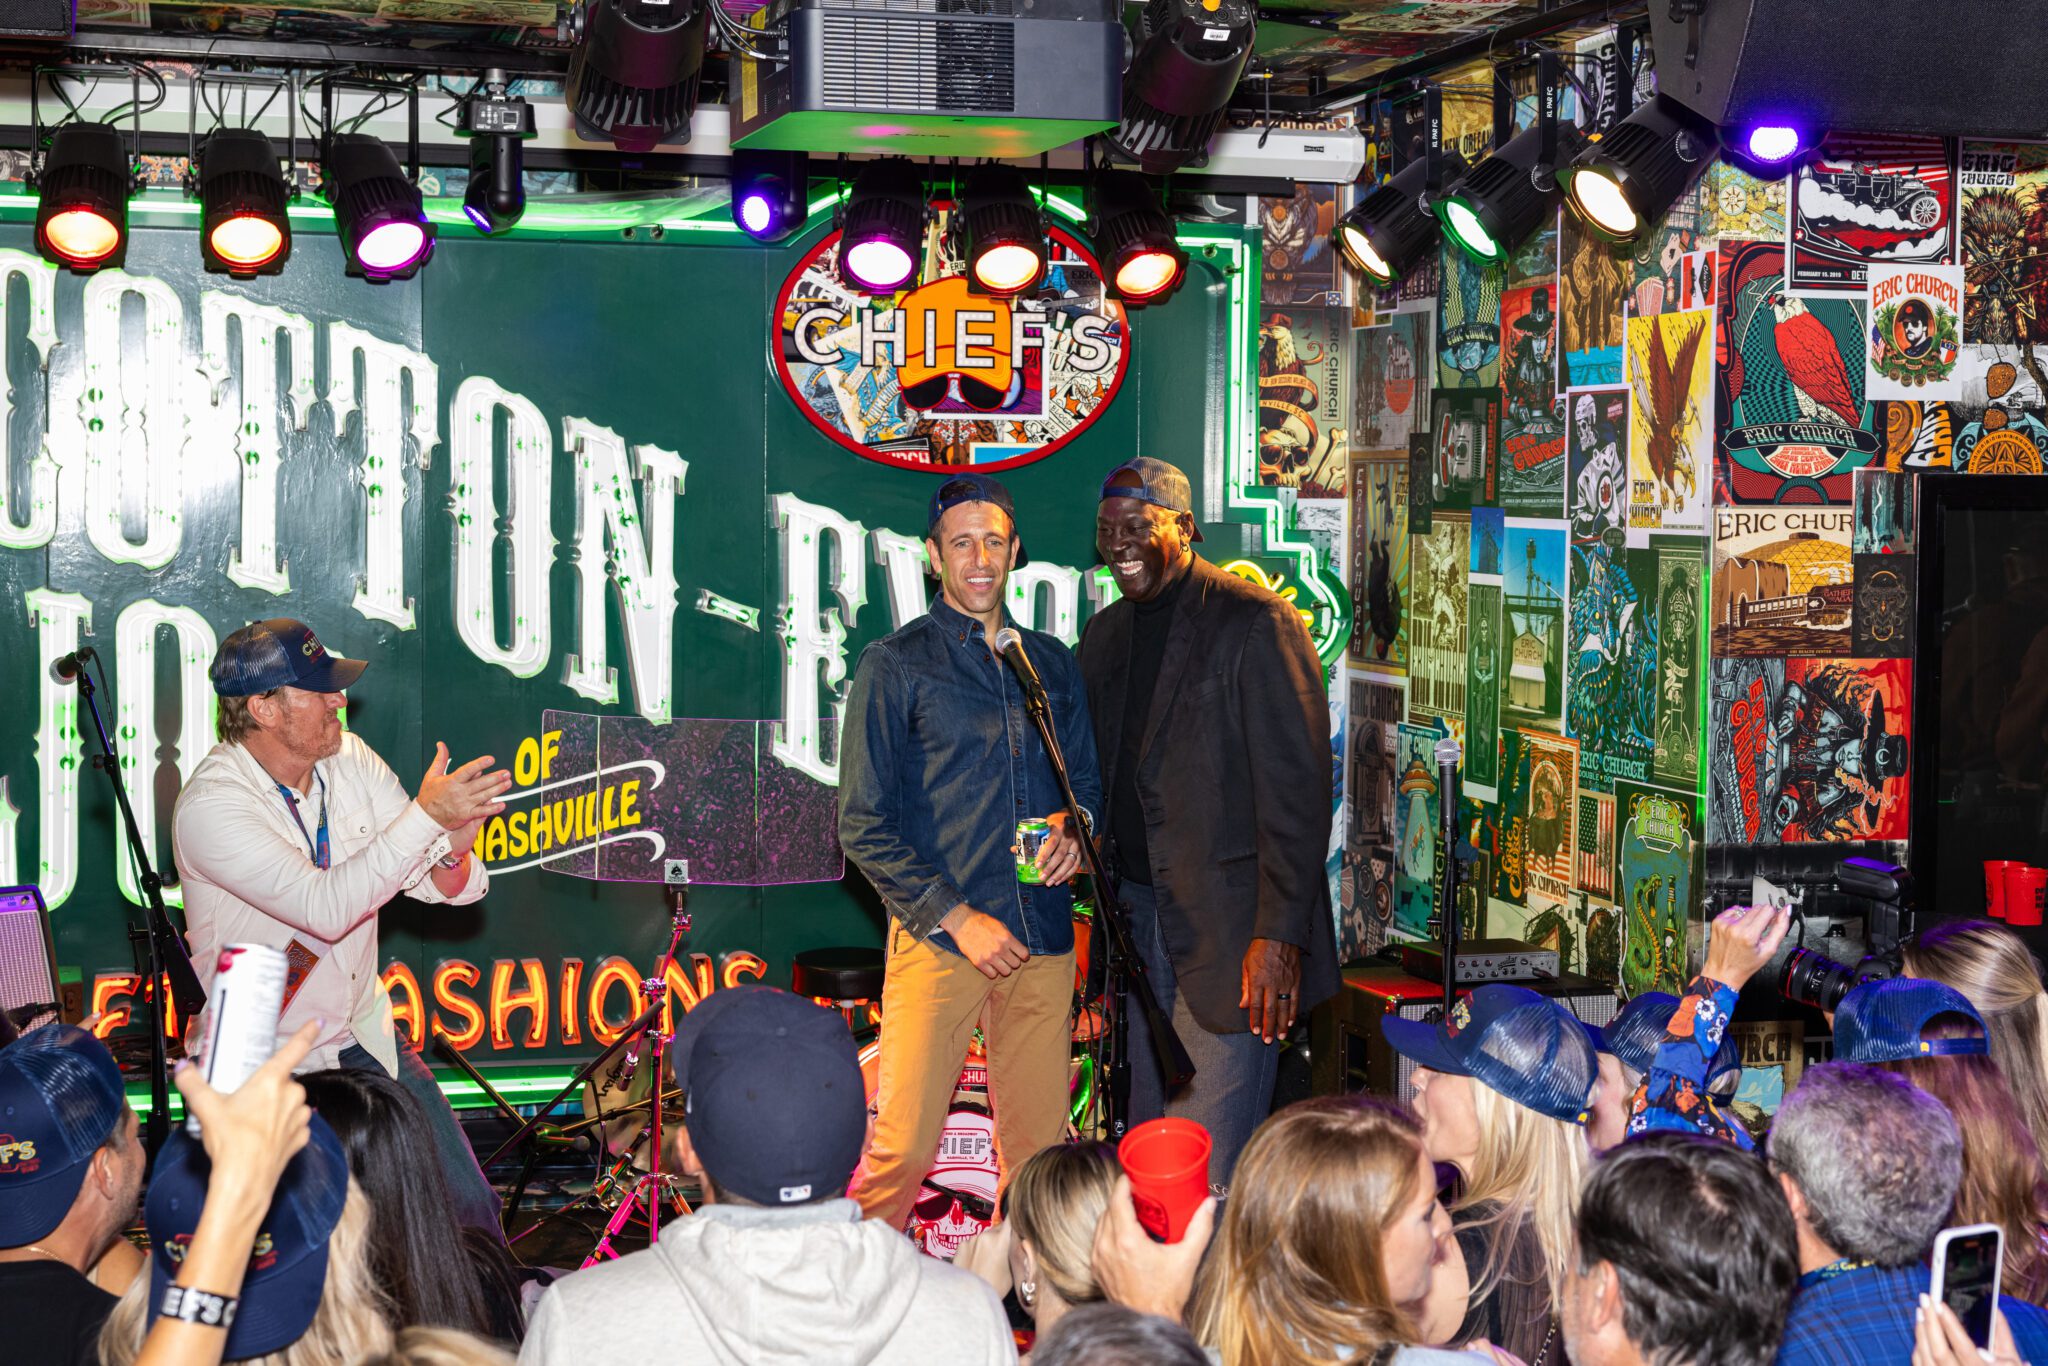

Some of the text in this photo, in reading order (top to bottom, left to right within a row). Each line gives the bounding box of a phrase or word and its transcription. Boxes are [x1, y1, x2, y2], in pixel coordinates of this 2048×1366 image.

[1547, 86, 1553, 95] FC
[1432, 118, 1438, 127] FC
[1797, 270, 1821, 278] FEBRUARY
[1872, 272, 1959, 313] ERIC CHURCH
[793, 307, 1111, 372] CHIEF'S
[1328, 357, 1340, 418] CHURCH
[1505, 433, 1538, 454] ERIC
[1742, 424, 1858, 448] ERIC CHURCH
[1633, 480, 1656, 503] ERIC
[1717, 513, 1776, 542] ERIC
[1514, 649, 1542, 661] CHURCH
[1520, 638, 1536, 649] ERIC
[1749, 676, 1767, 753] ERIC
[514, 730, 562, 786] OF
[1413, 734, 1440, 779] CHURC
[1602, 752, 1646, 781] CHURCH
[1730, 699, 1761, 844] CHURCH
[1651, 805, 1668, 821] ERIC
[1644, 819, 1674, 839] CHURCH
[364, 950, 768, 1053] ASHION
